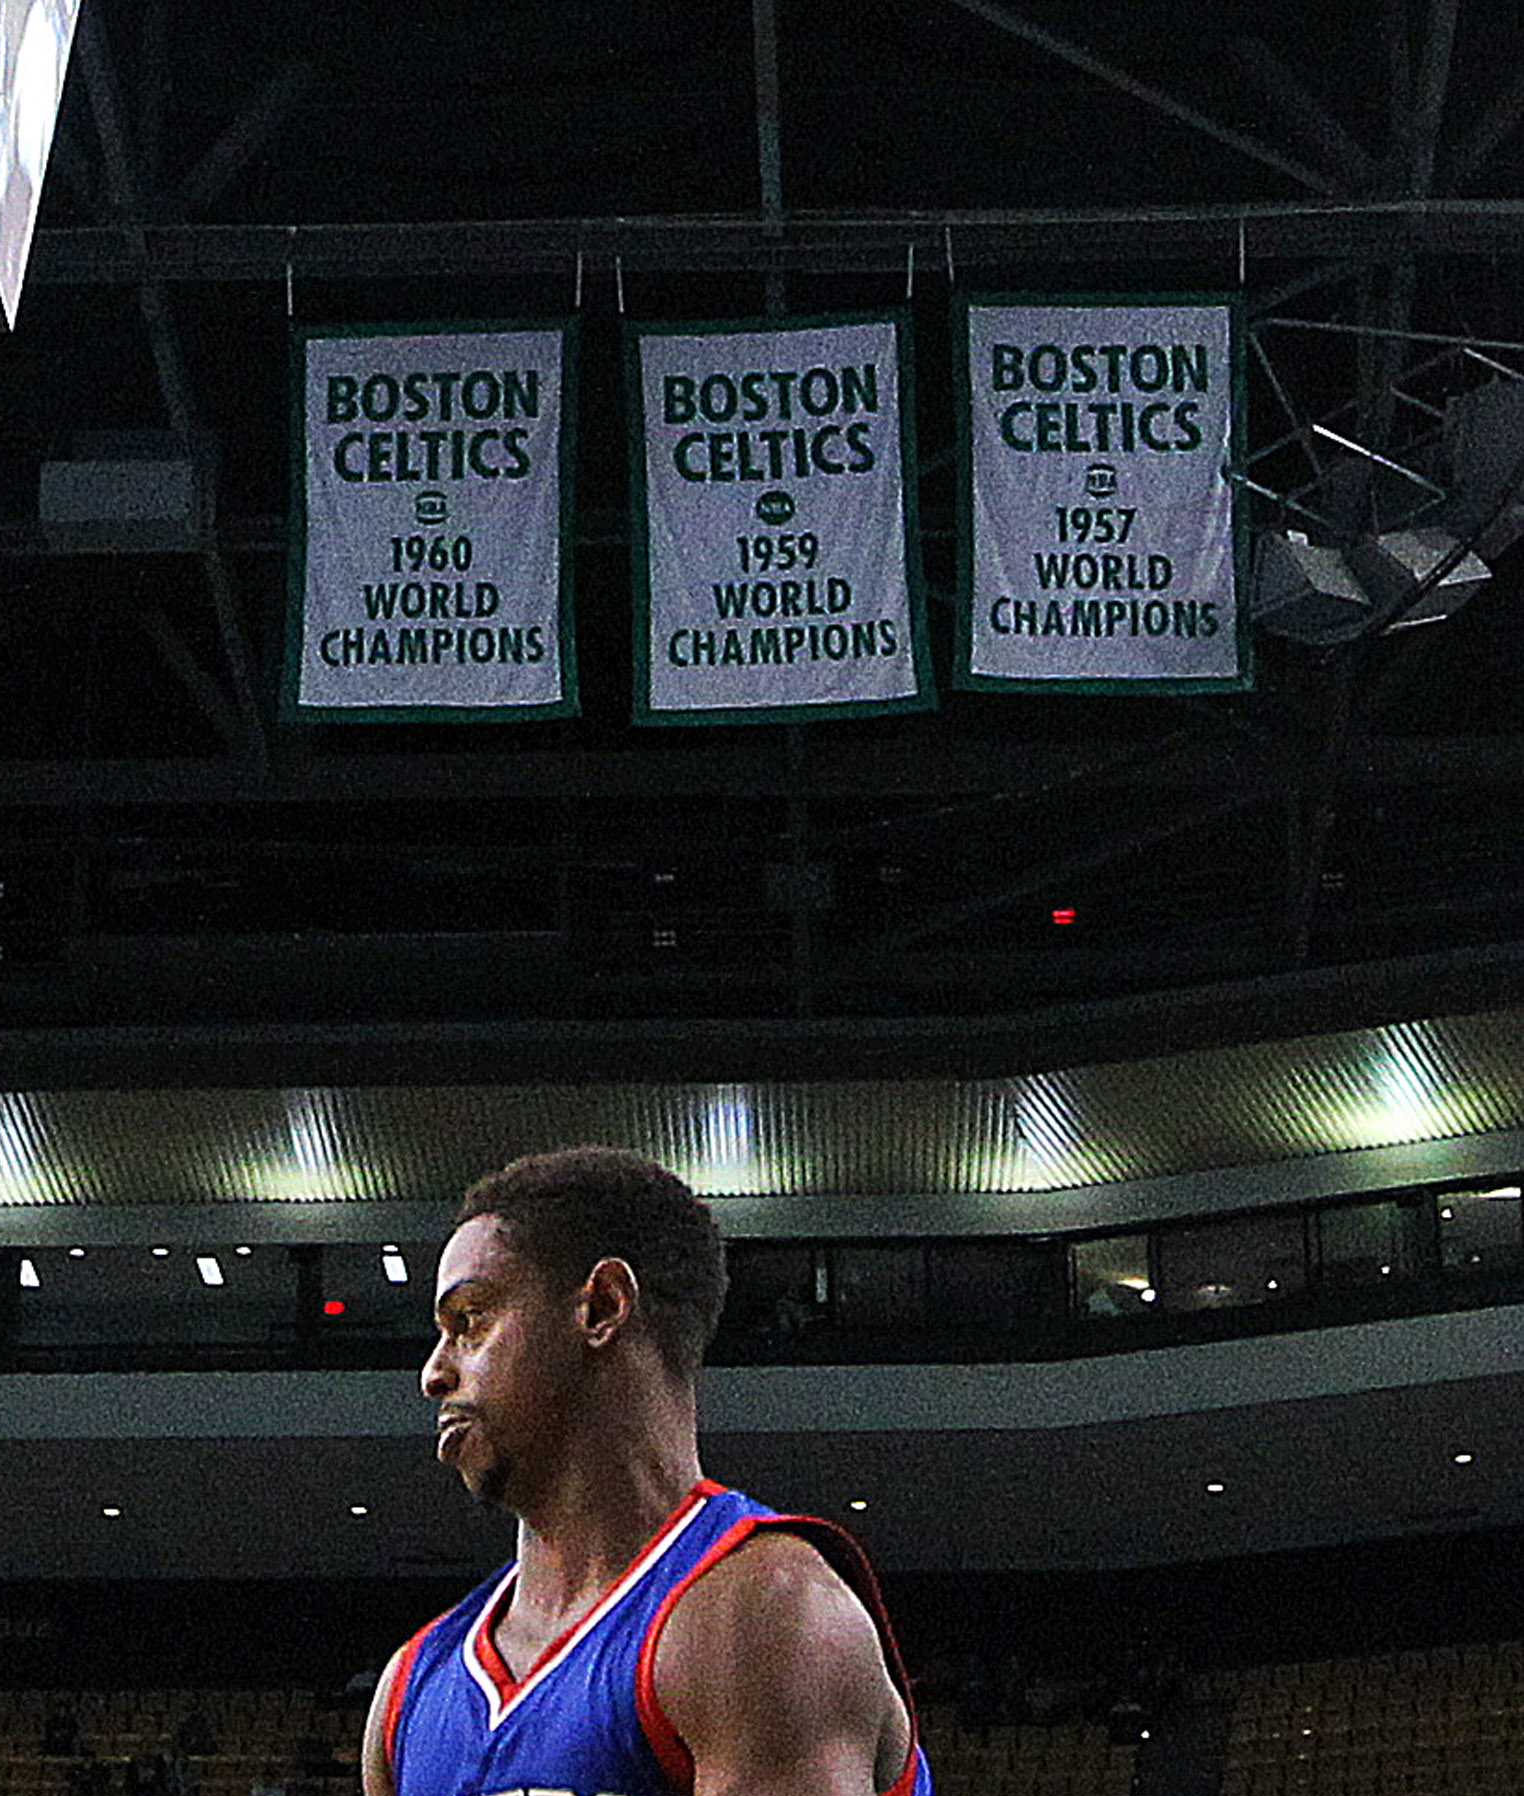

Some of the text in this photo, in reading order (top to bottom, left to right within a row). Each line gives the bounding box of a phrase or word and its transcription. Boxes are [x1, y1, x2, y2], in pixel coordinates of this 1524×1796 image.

[992, 343, 1208, 393] BOSTON
[328, 370, 539, 423] BOSTON
[663, 363, 878, 424] BOSTON
[1000, 402, 1203, 452] CELTICS
[334, 427, 531, 482] CELTICS
[673, 422, 876, 483] CELTICS
[1055, 507, 1138, 544] 1957
[391, 535, 473, 572] 1960
[736, 531, 819, 573] 1959
[1034, 552, 1174, 591] WORLD
[363, 582, 500, 620] WORLD
[712, 577, 852, 619] WORLD
[990, 597, 1219, 637] CHAMPIONS
[320, 626, 546, 667] CHAMPIONS
[668, 618, 898, 668] CHAMPIONS
